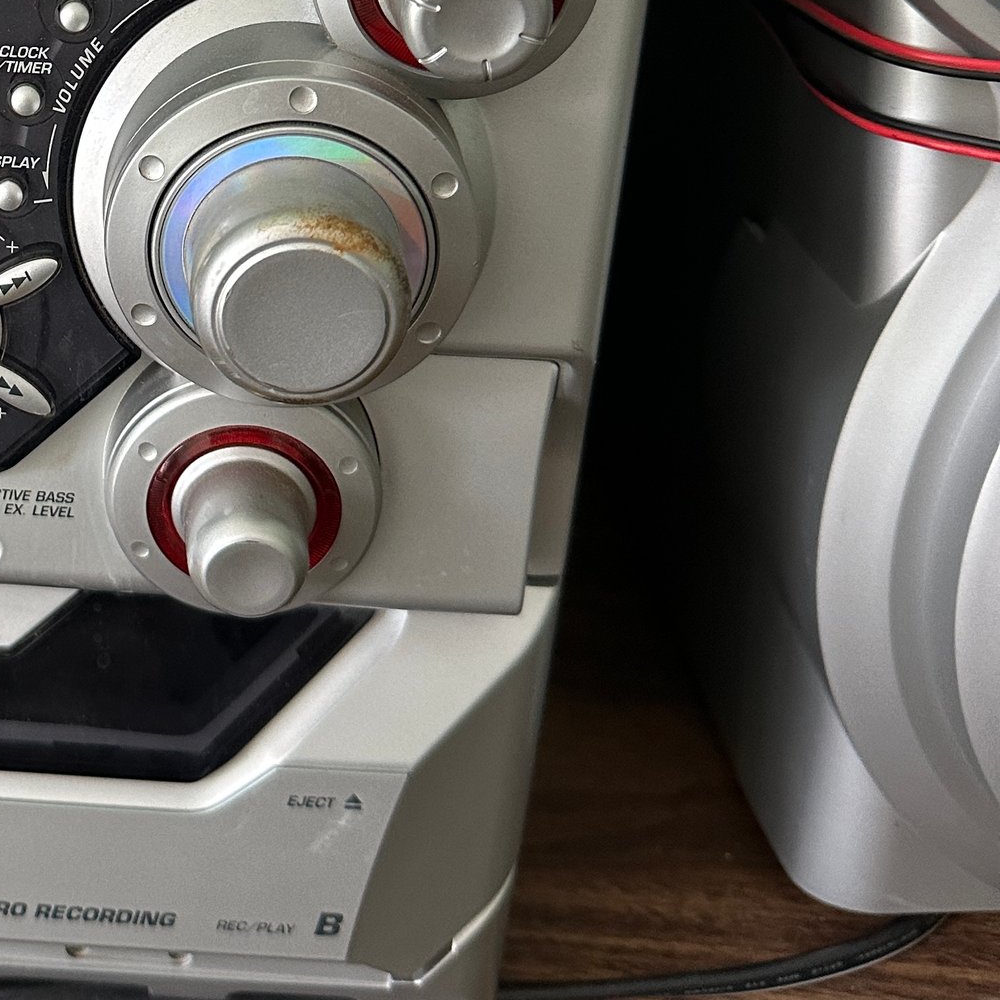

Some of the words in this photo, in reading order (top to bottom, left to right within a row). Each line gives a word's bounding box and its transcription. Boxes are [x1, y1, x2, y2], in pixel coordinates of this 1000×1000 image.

[0, 45, 50, 60] CLOCK
[52, 37, 105, 114] VOLUME
[35, 489, 75, 504] BASS
[4, 503, 27, 516] EX.
[31, 504, 75, 518] LEVEL
[286, 794, 336, 809] EJECT
[34, 903, 177, 929] RECORDING
[314, 911, 344, 937] B
[216, 918, 296, 936] REC/PLAY
